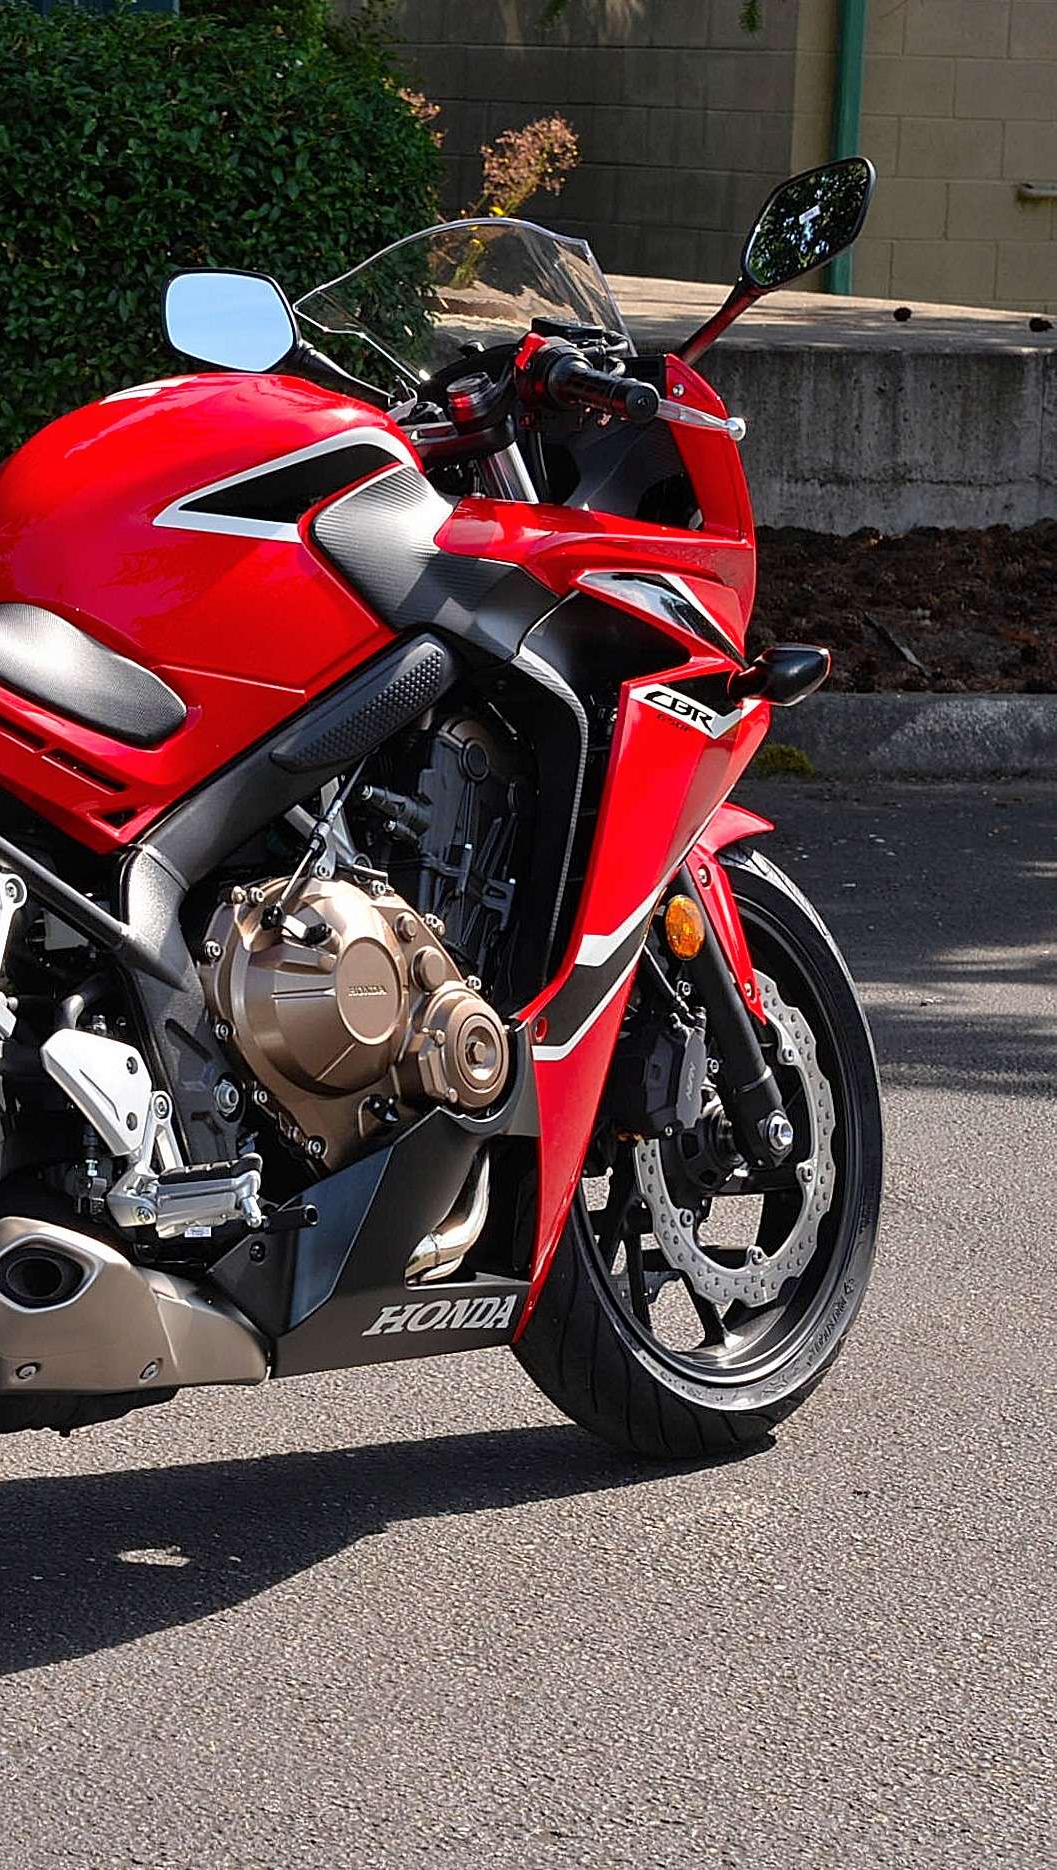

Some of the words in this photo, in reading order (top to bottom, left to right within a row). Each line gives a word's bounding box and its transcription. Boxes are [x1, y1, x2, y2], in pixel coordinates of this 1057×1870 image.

[644, 690, 714, 735] CBR
[348, 984, 389, 997] HONDA
[361, 1294, 518, 1337] HONDA
